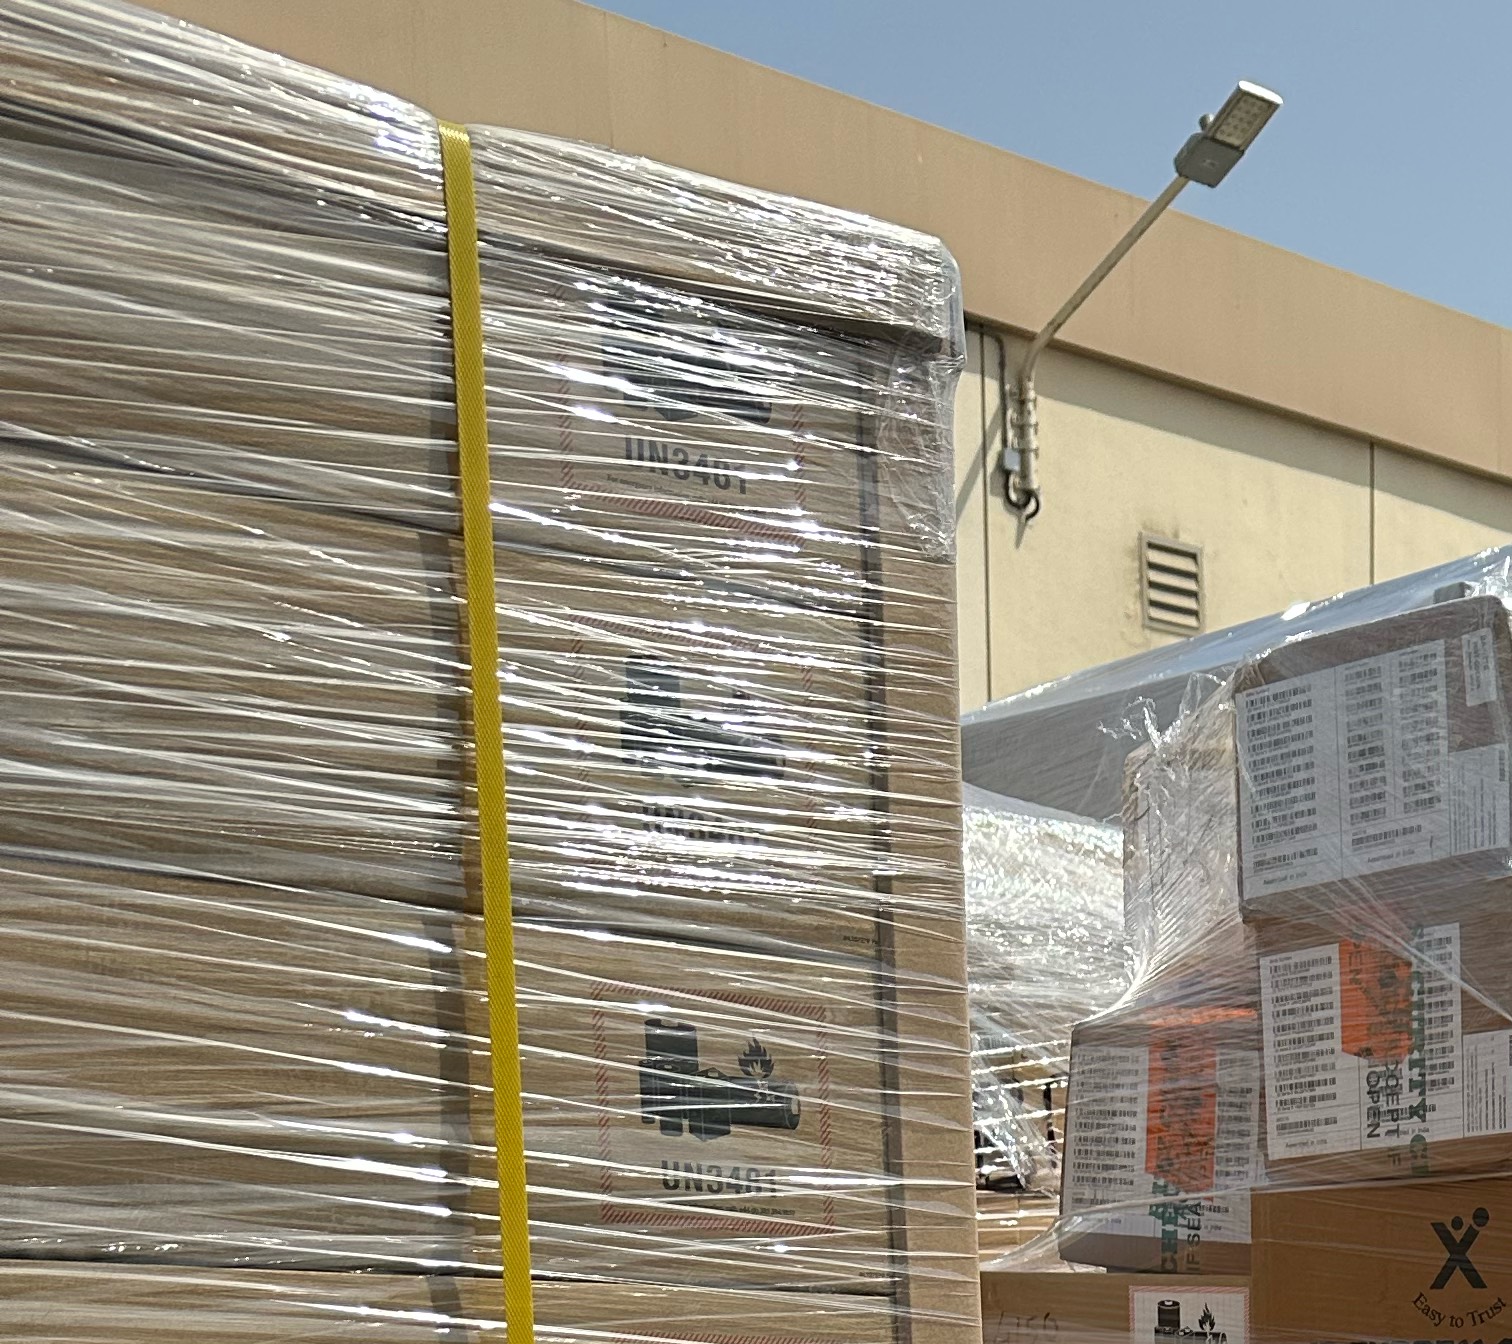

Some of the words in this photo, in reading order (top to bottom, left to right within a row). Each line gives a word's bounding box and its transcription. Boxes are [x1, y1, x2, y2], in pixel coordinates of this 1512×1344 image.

[1411, 1291, 1446, 1328] Easy
[1450, 1312, 1464, 1329] to
[1467, 1296, 1508, 1328] Trust
